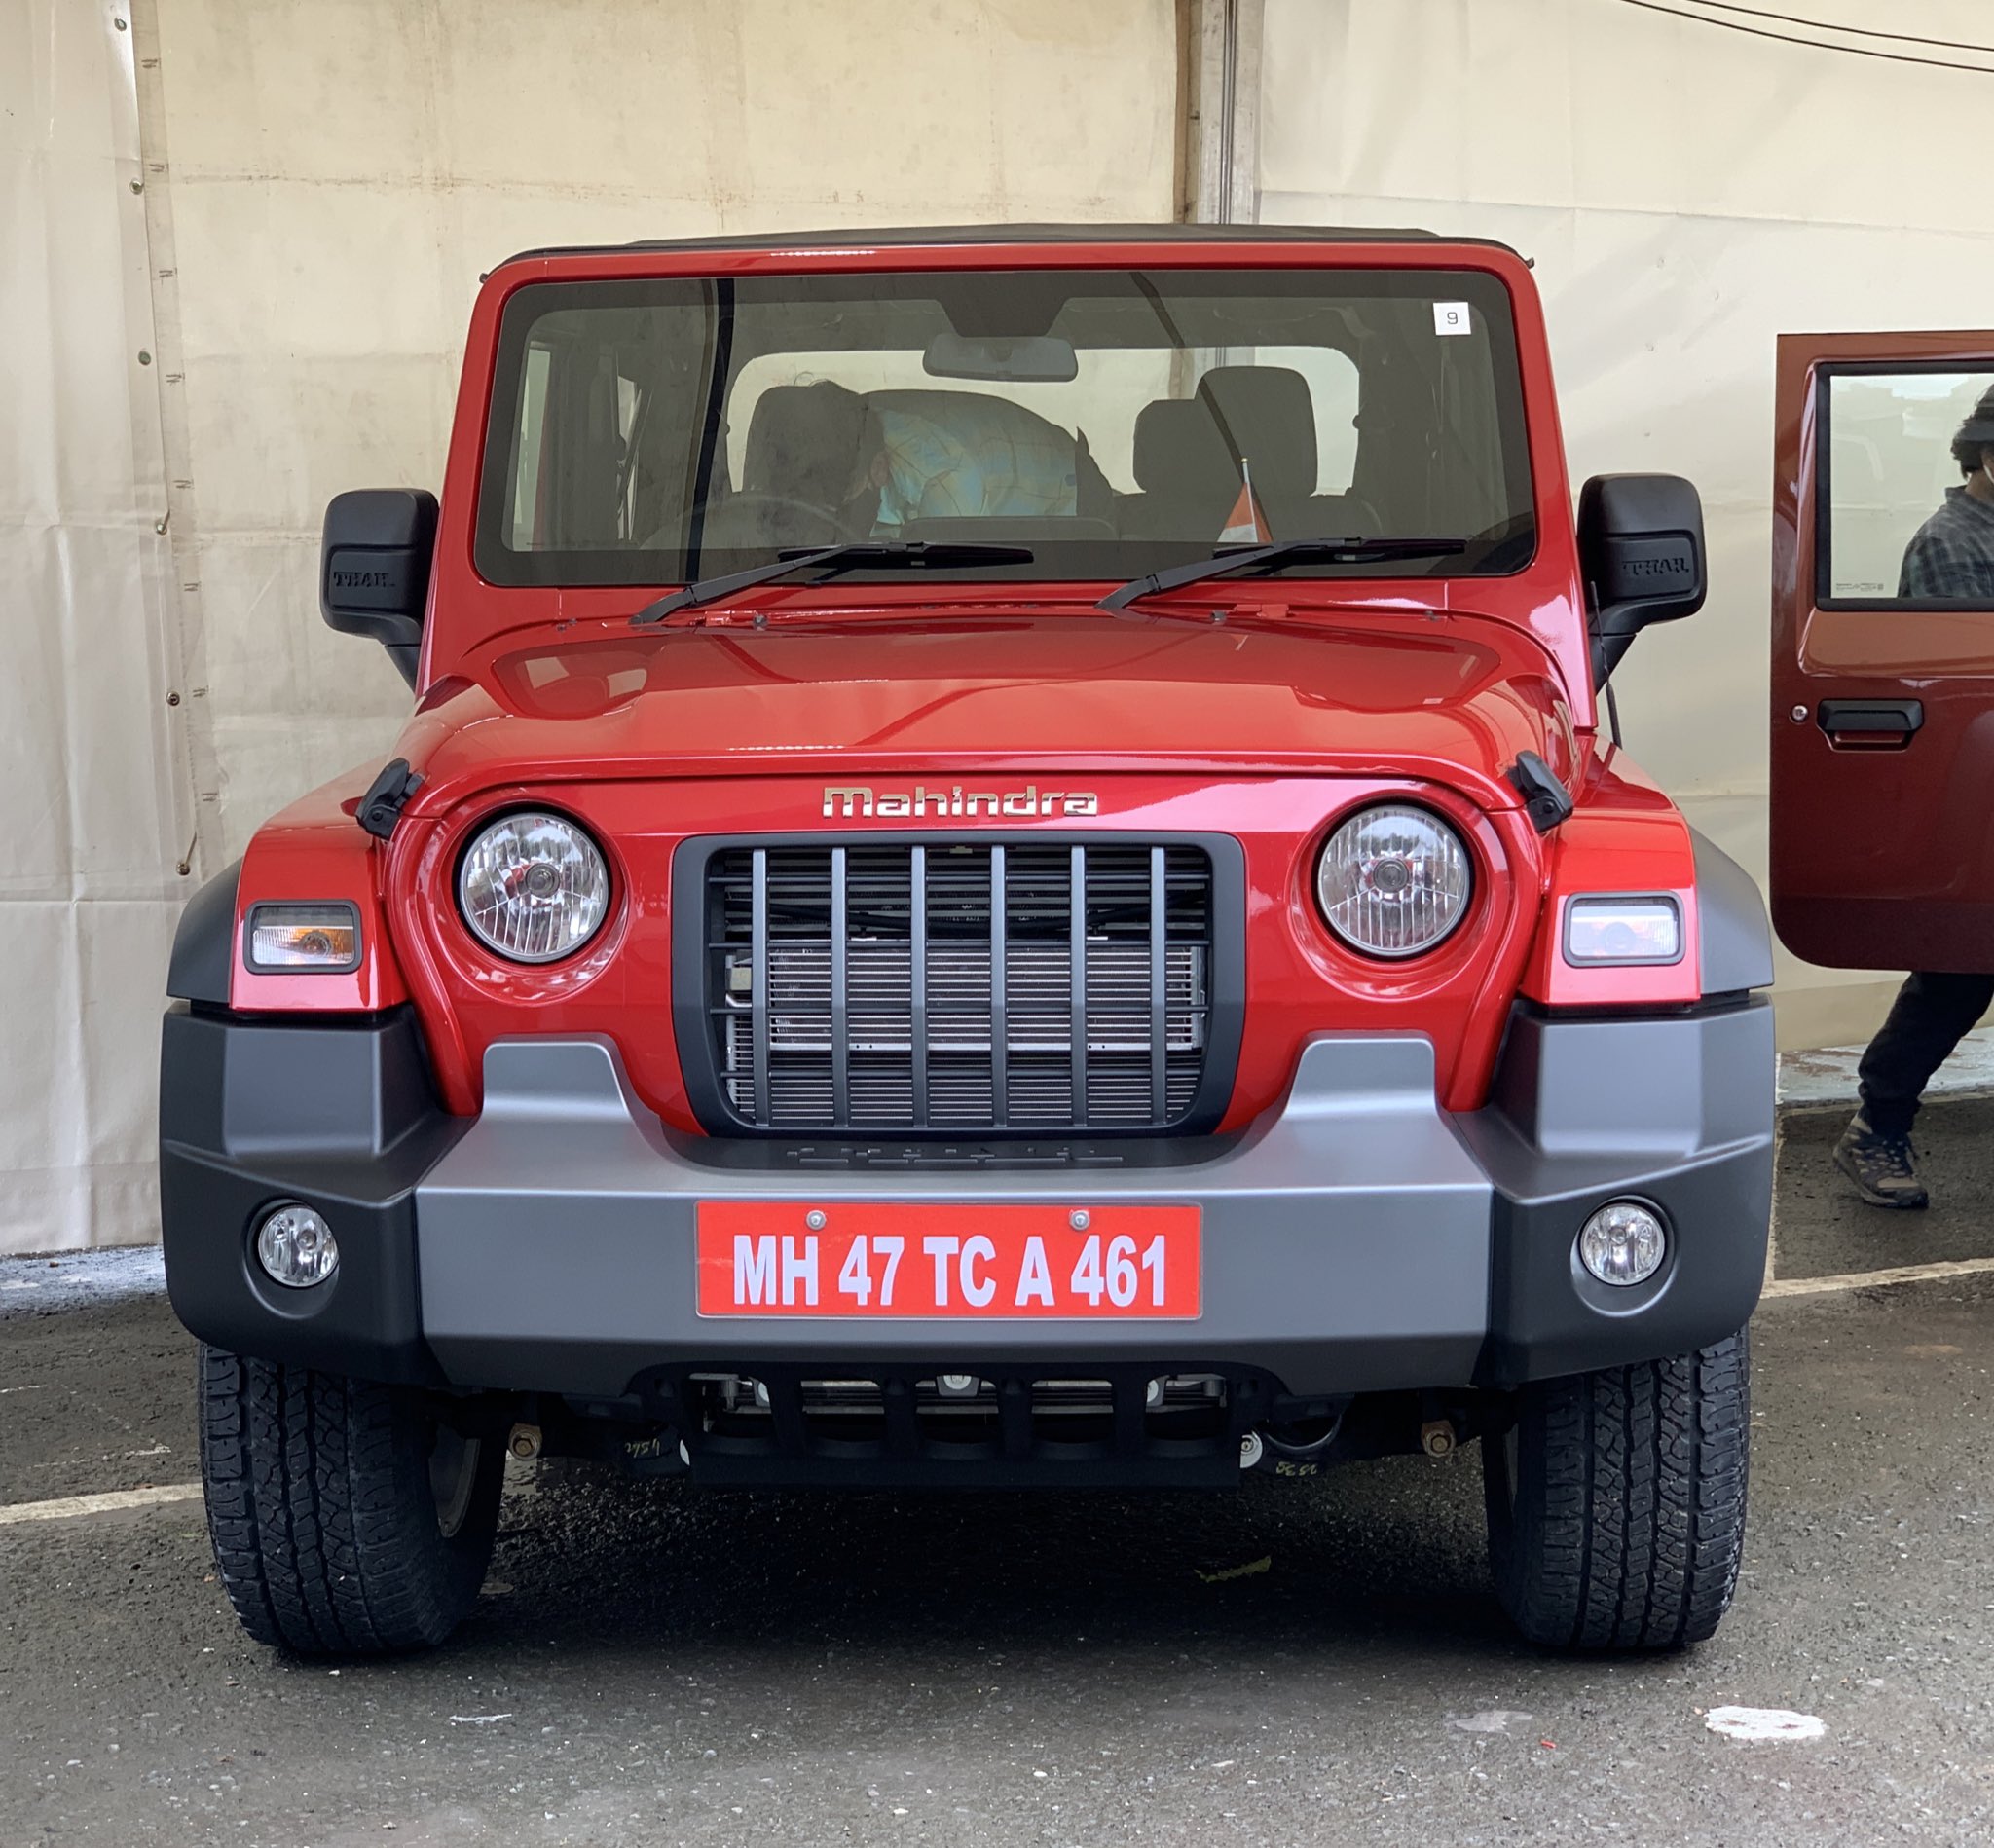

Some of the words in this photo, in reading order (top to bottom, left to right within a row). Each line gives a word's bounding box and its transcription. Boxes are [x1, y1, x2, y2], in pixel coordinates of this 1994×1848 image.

[1447, 312, 1459, 325] 9
[733, 1235, 820, 1306] MH
[838, 1235, 905, 1306] 47
[923, 1235, 997, 1308] TC
[1015, 1235, 1055, 1307] A
[1071, 1235, 1166, 1307] 461
